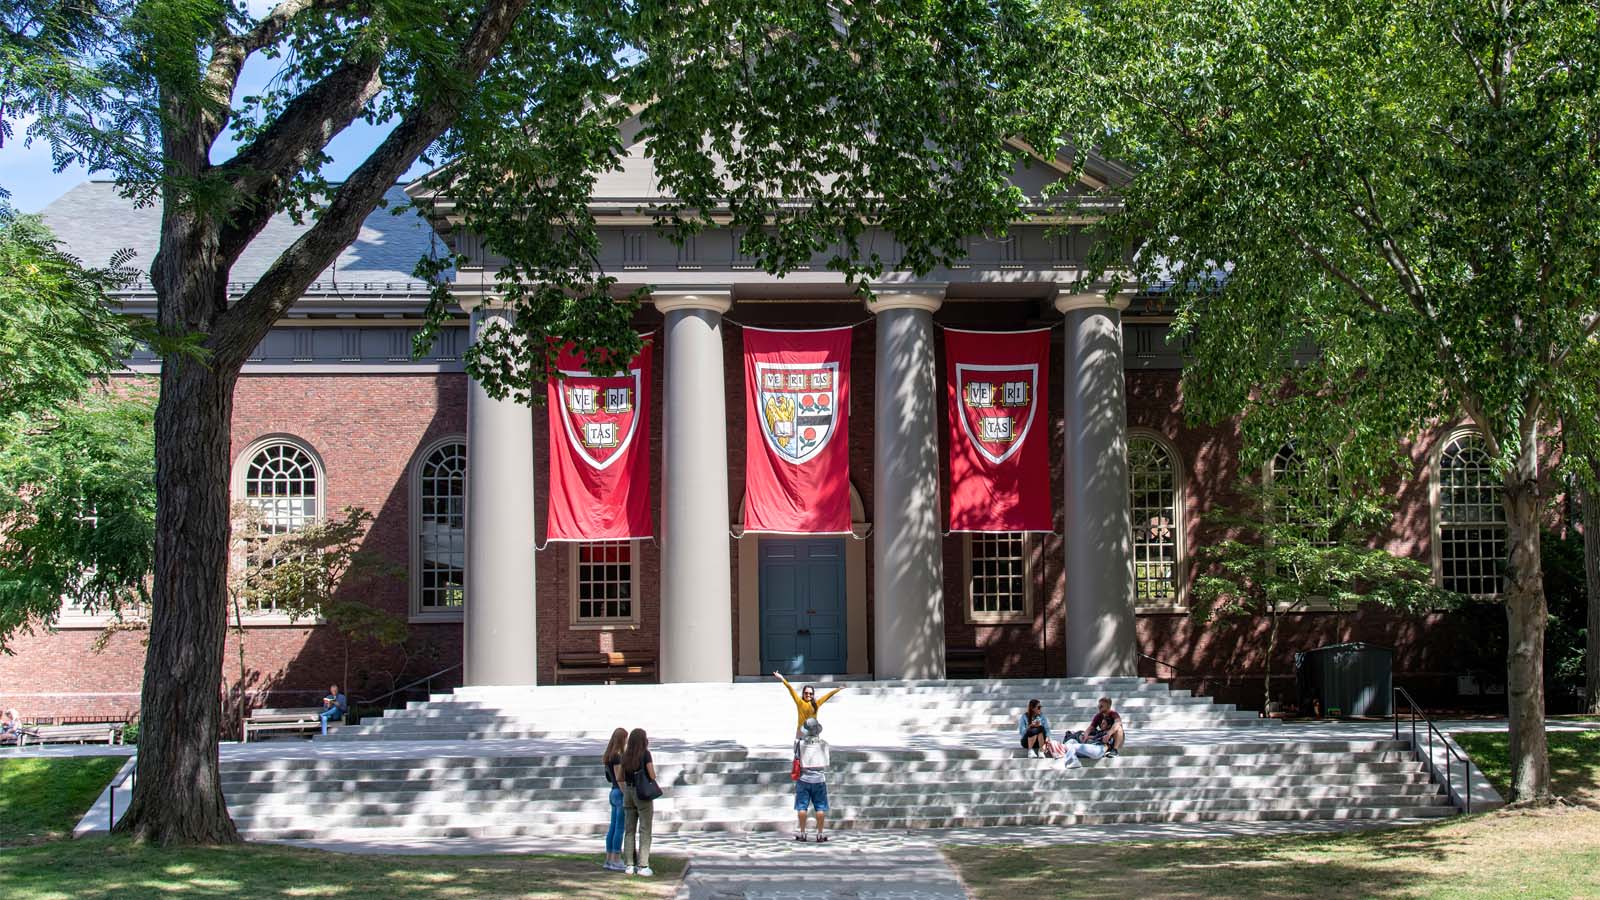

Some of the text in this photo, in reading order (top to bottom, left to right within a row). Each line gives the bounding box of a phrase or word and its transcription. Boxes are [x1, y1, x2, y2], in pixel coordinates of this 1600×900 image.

[768, 376, 780, 384] VE
[791, 376, 802, 384] RI
[972, 388, 1020, 399] VE RI
[574, 394, 623, 406] VE RI
[988, 422, 1008, 433] TAS
[590, 428, 611, 439] TAS
